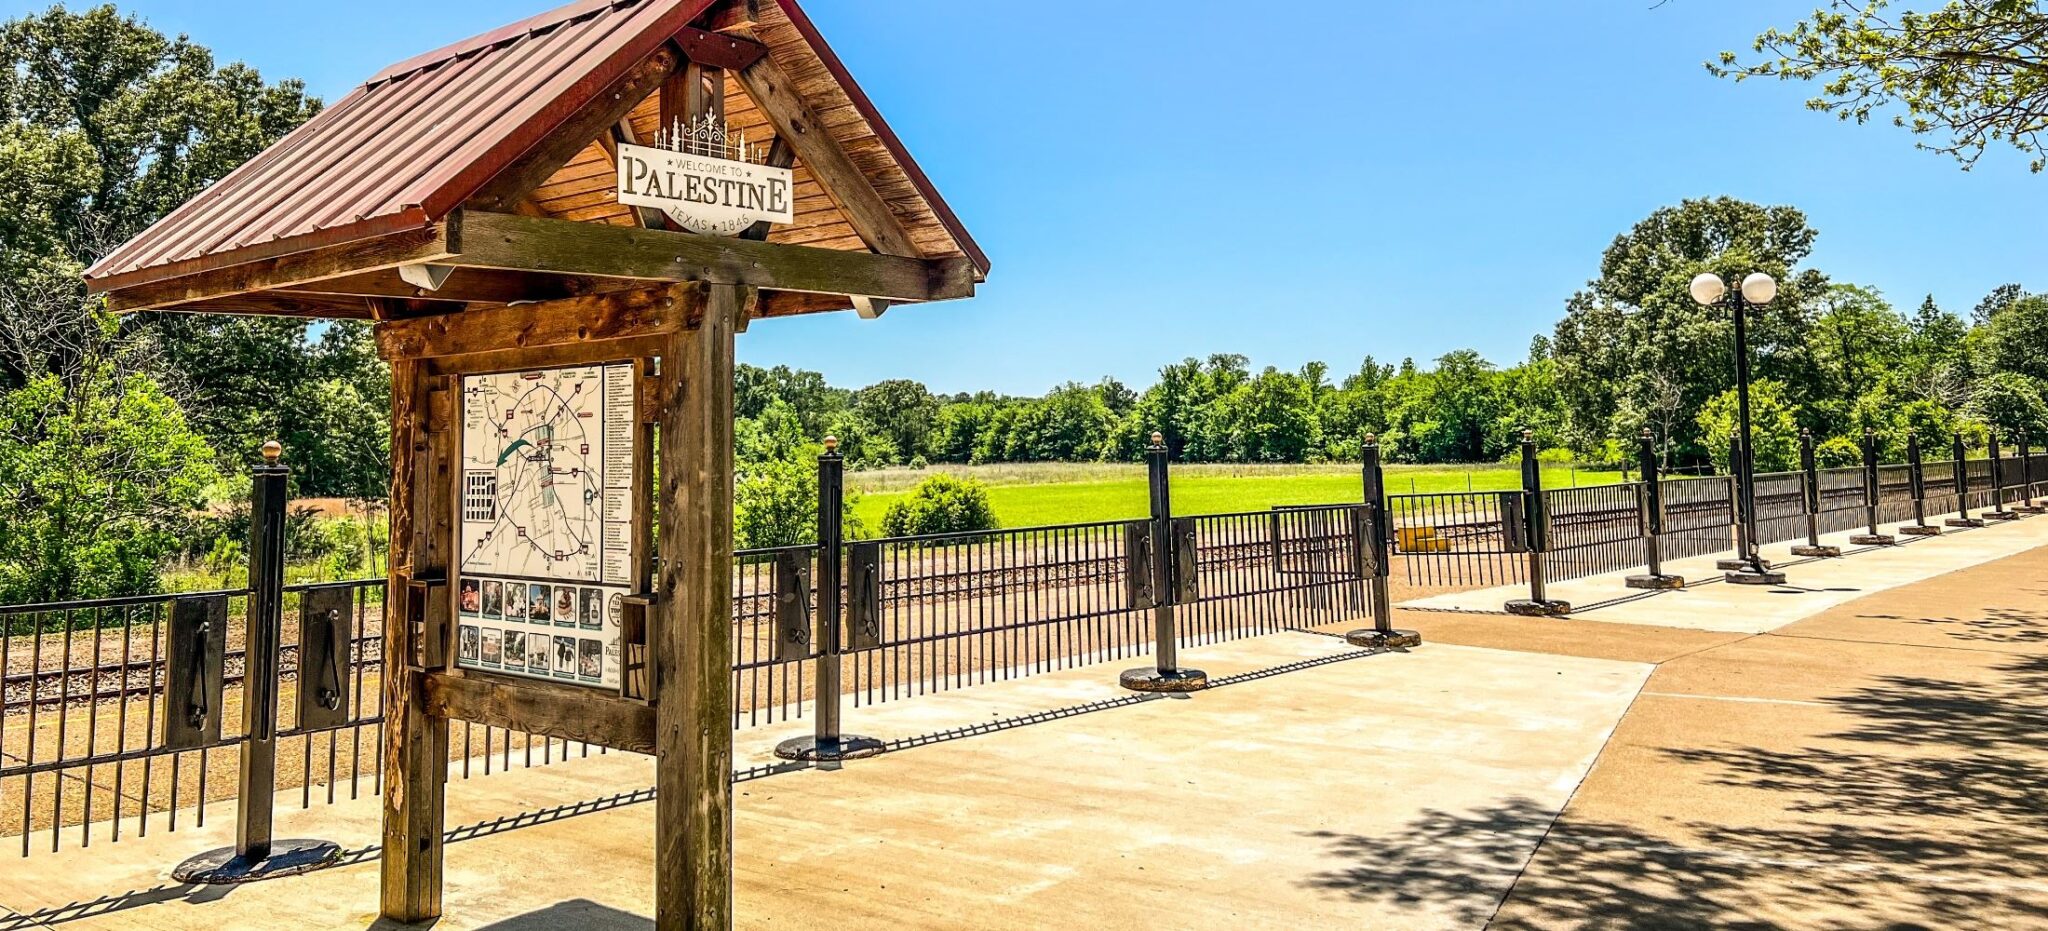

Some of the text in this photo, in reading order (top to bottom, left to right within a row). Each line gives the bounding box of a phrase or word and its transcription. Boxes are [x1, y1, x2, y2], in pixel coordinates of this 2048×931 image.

[675, 158, 743, 177] WELCOME TO
[622, 156, 787, 214] PALESTINE
[670, 204, 750, 232] TEXAS 1846
